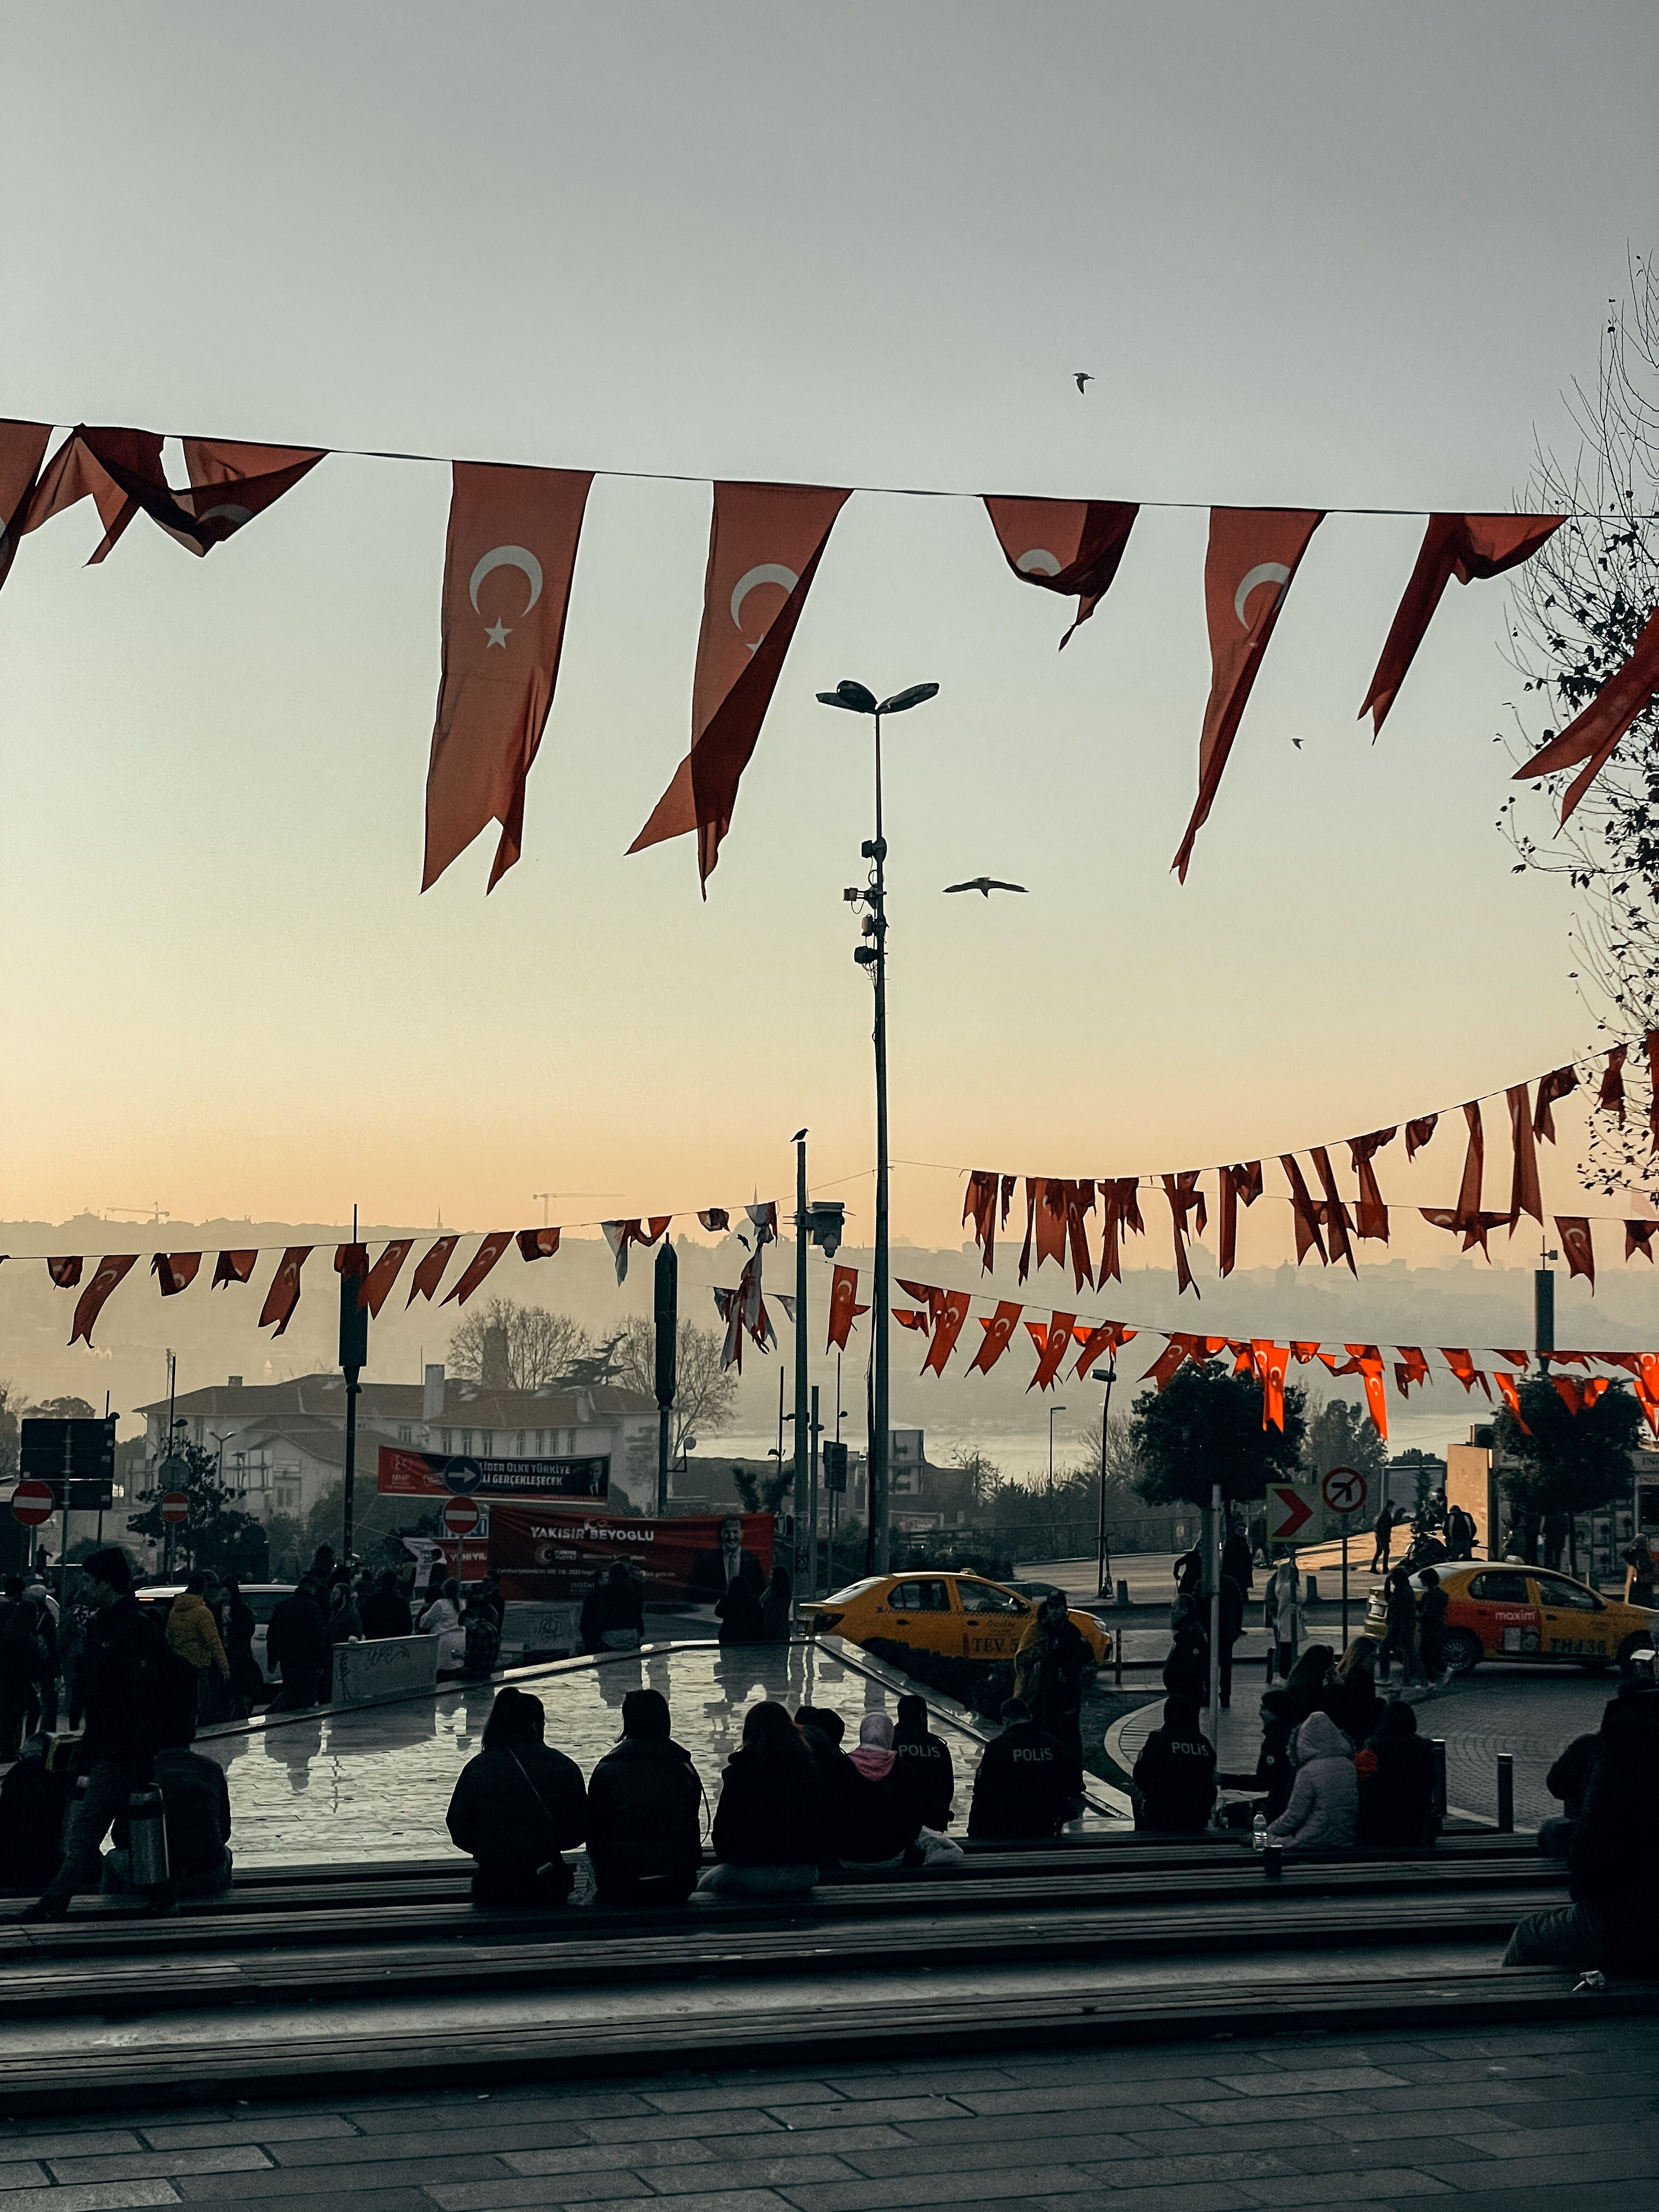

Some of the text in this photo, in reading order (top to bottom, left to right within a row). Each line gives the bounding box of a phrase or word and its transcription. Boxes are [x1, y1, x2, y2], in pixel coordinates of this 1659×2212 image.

[531, 1463, 570, 1475] TÜRKİYE
[492, 1475, 562, 1487] GERÇEKLEŞECEK
[1496, 1610, 1535, 1621] maxim
[972, 1637, 1004, 1652] TEV
